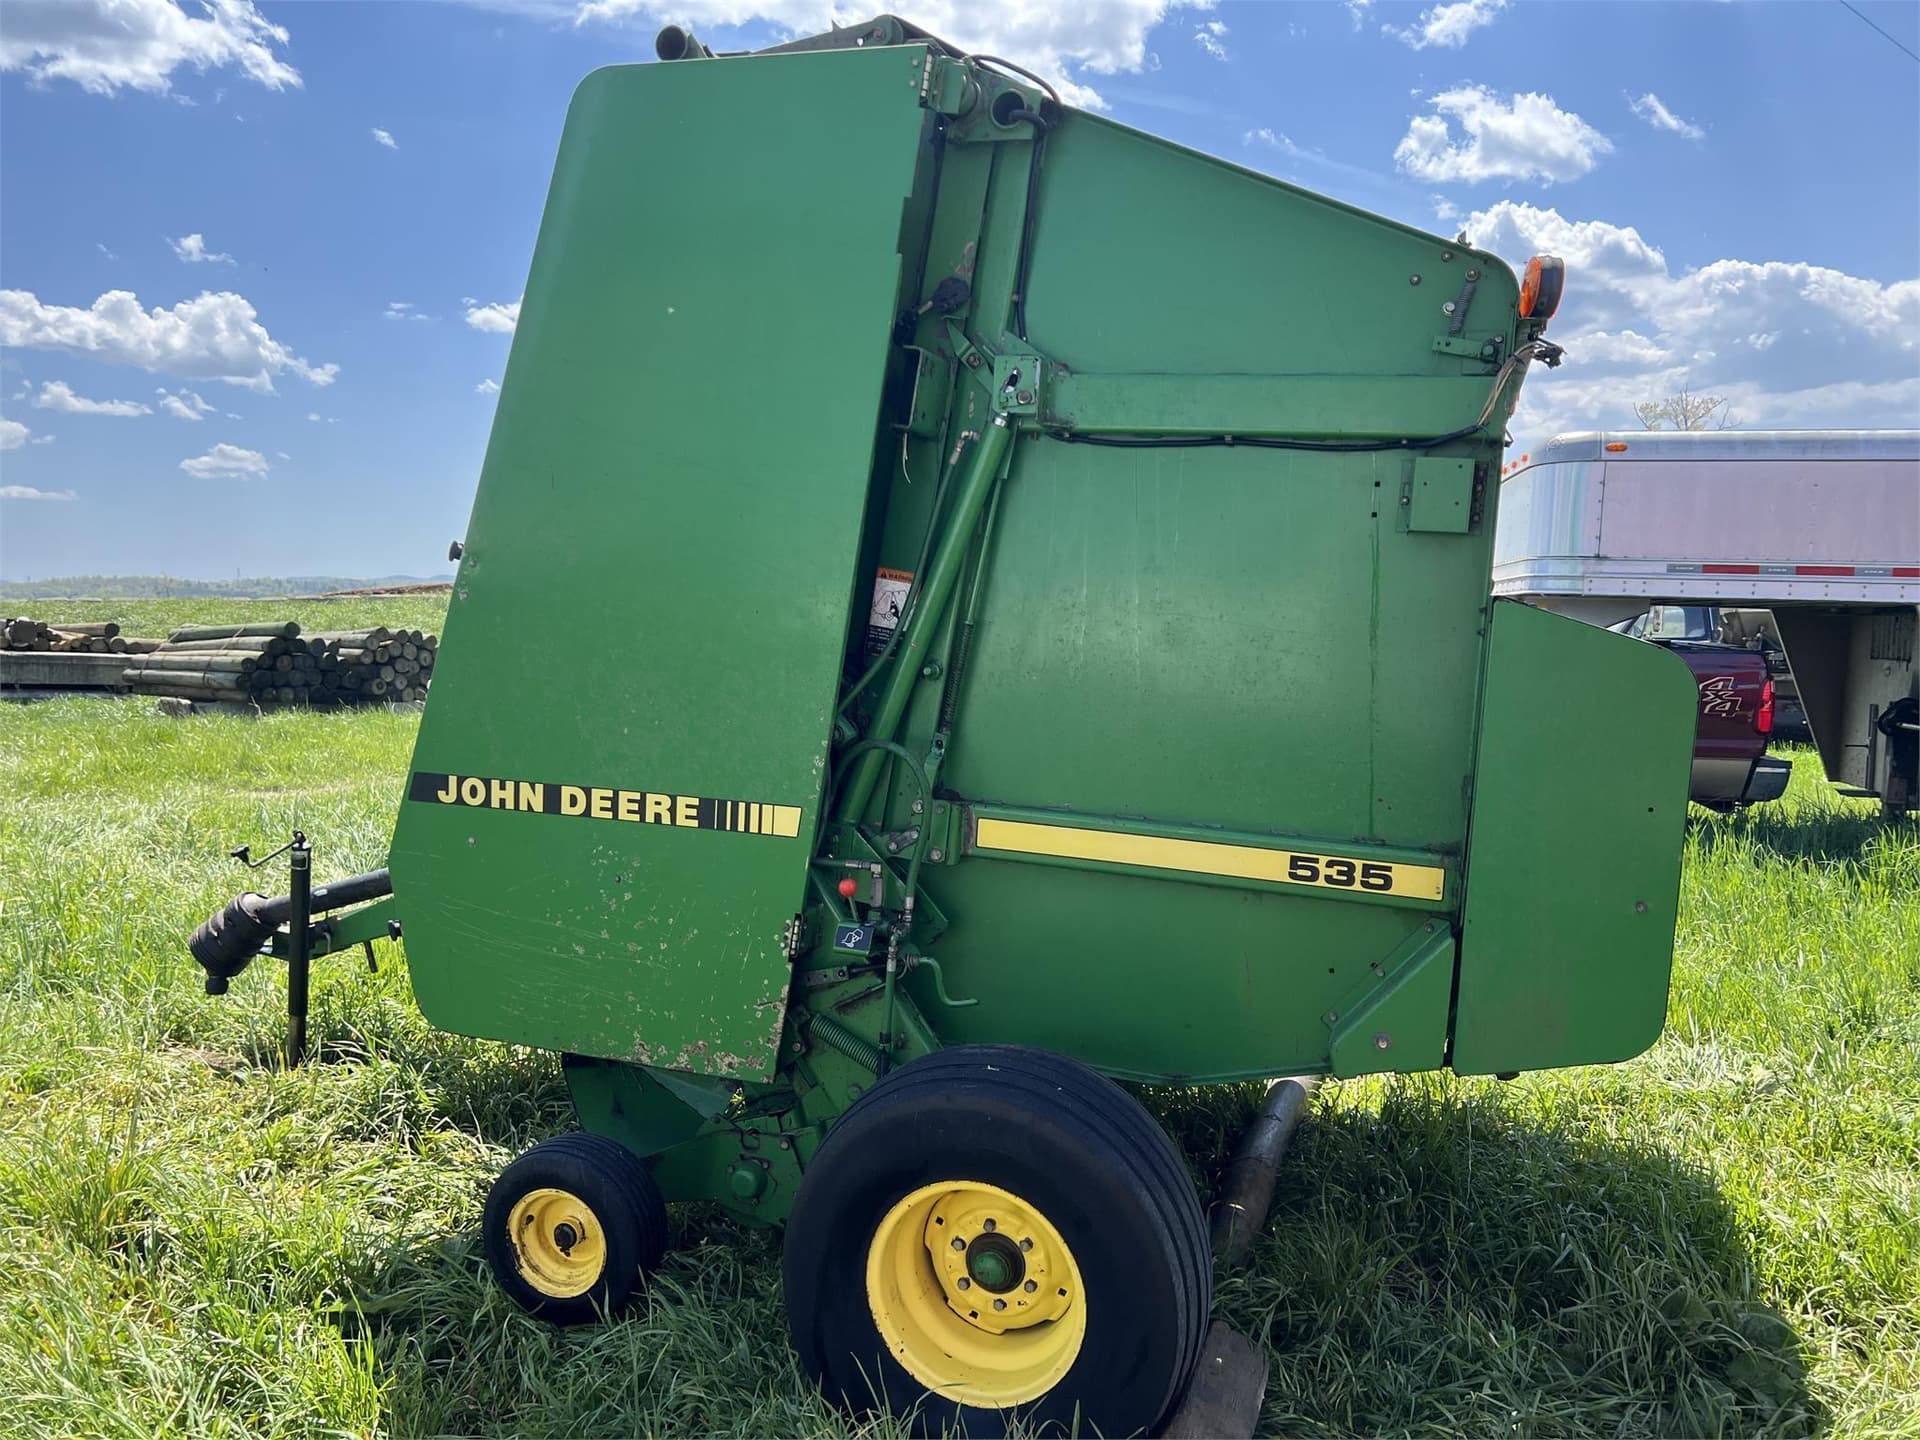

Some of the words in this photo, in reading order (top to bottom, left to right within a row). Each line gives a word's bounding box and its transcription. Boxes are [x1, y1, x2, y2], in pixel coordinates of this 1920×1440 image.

[437, 774, 544, 813] JOHN
[560, 785, 700, 828] DEERE
[1288, 855, 1392, 891] 535
